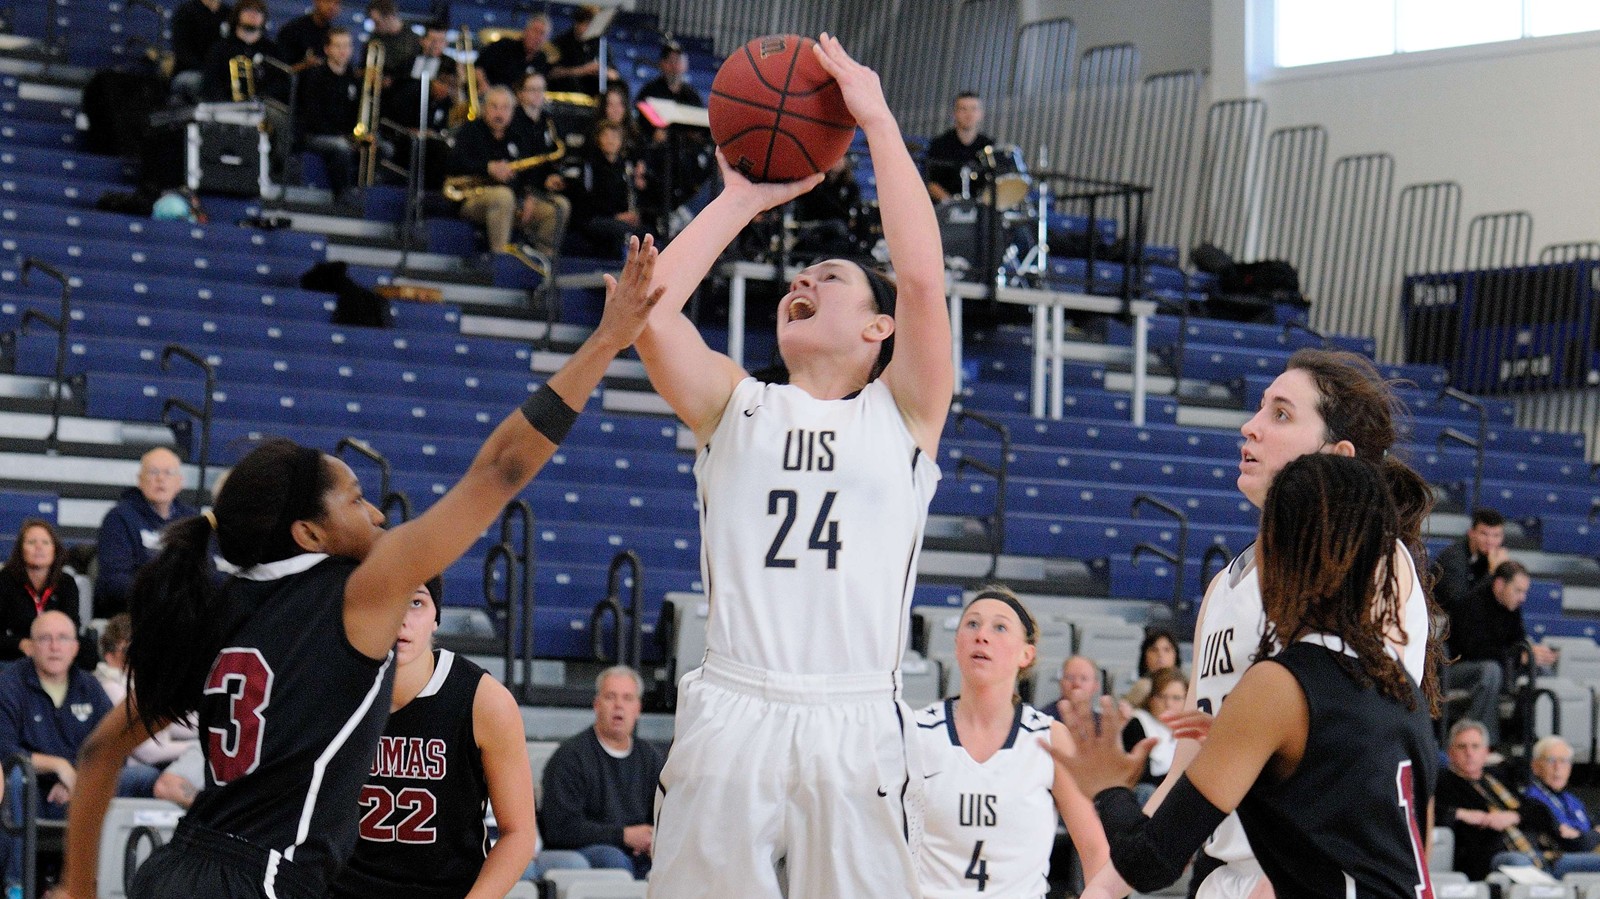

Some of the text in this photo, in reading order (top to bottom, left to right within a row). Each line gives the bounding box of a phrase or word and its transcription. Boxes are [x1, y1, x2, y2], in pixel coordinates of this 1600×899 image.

[783, 429, 835, 471] UIS
[765, 489, 842, 569] 24
[1201, 627, 1234, 679] UIS
[203, 647, 275, 786] 3
[358, 784, 437, 844] 22
[959, 793, 997, 827] UIS
[964, 840, 990, 892] 4
